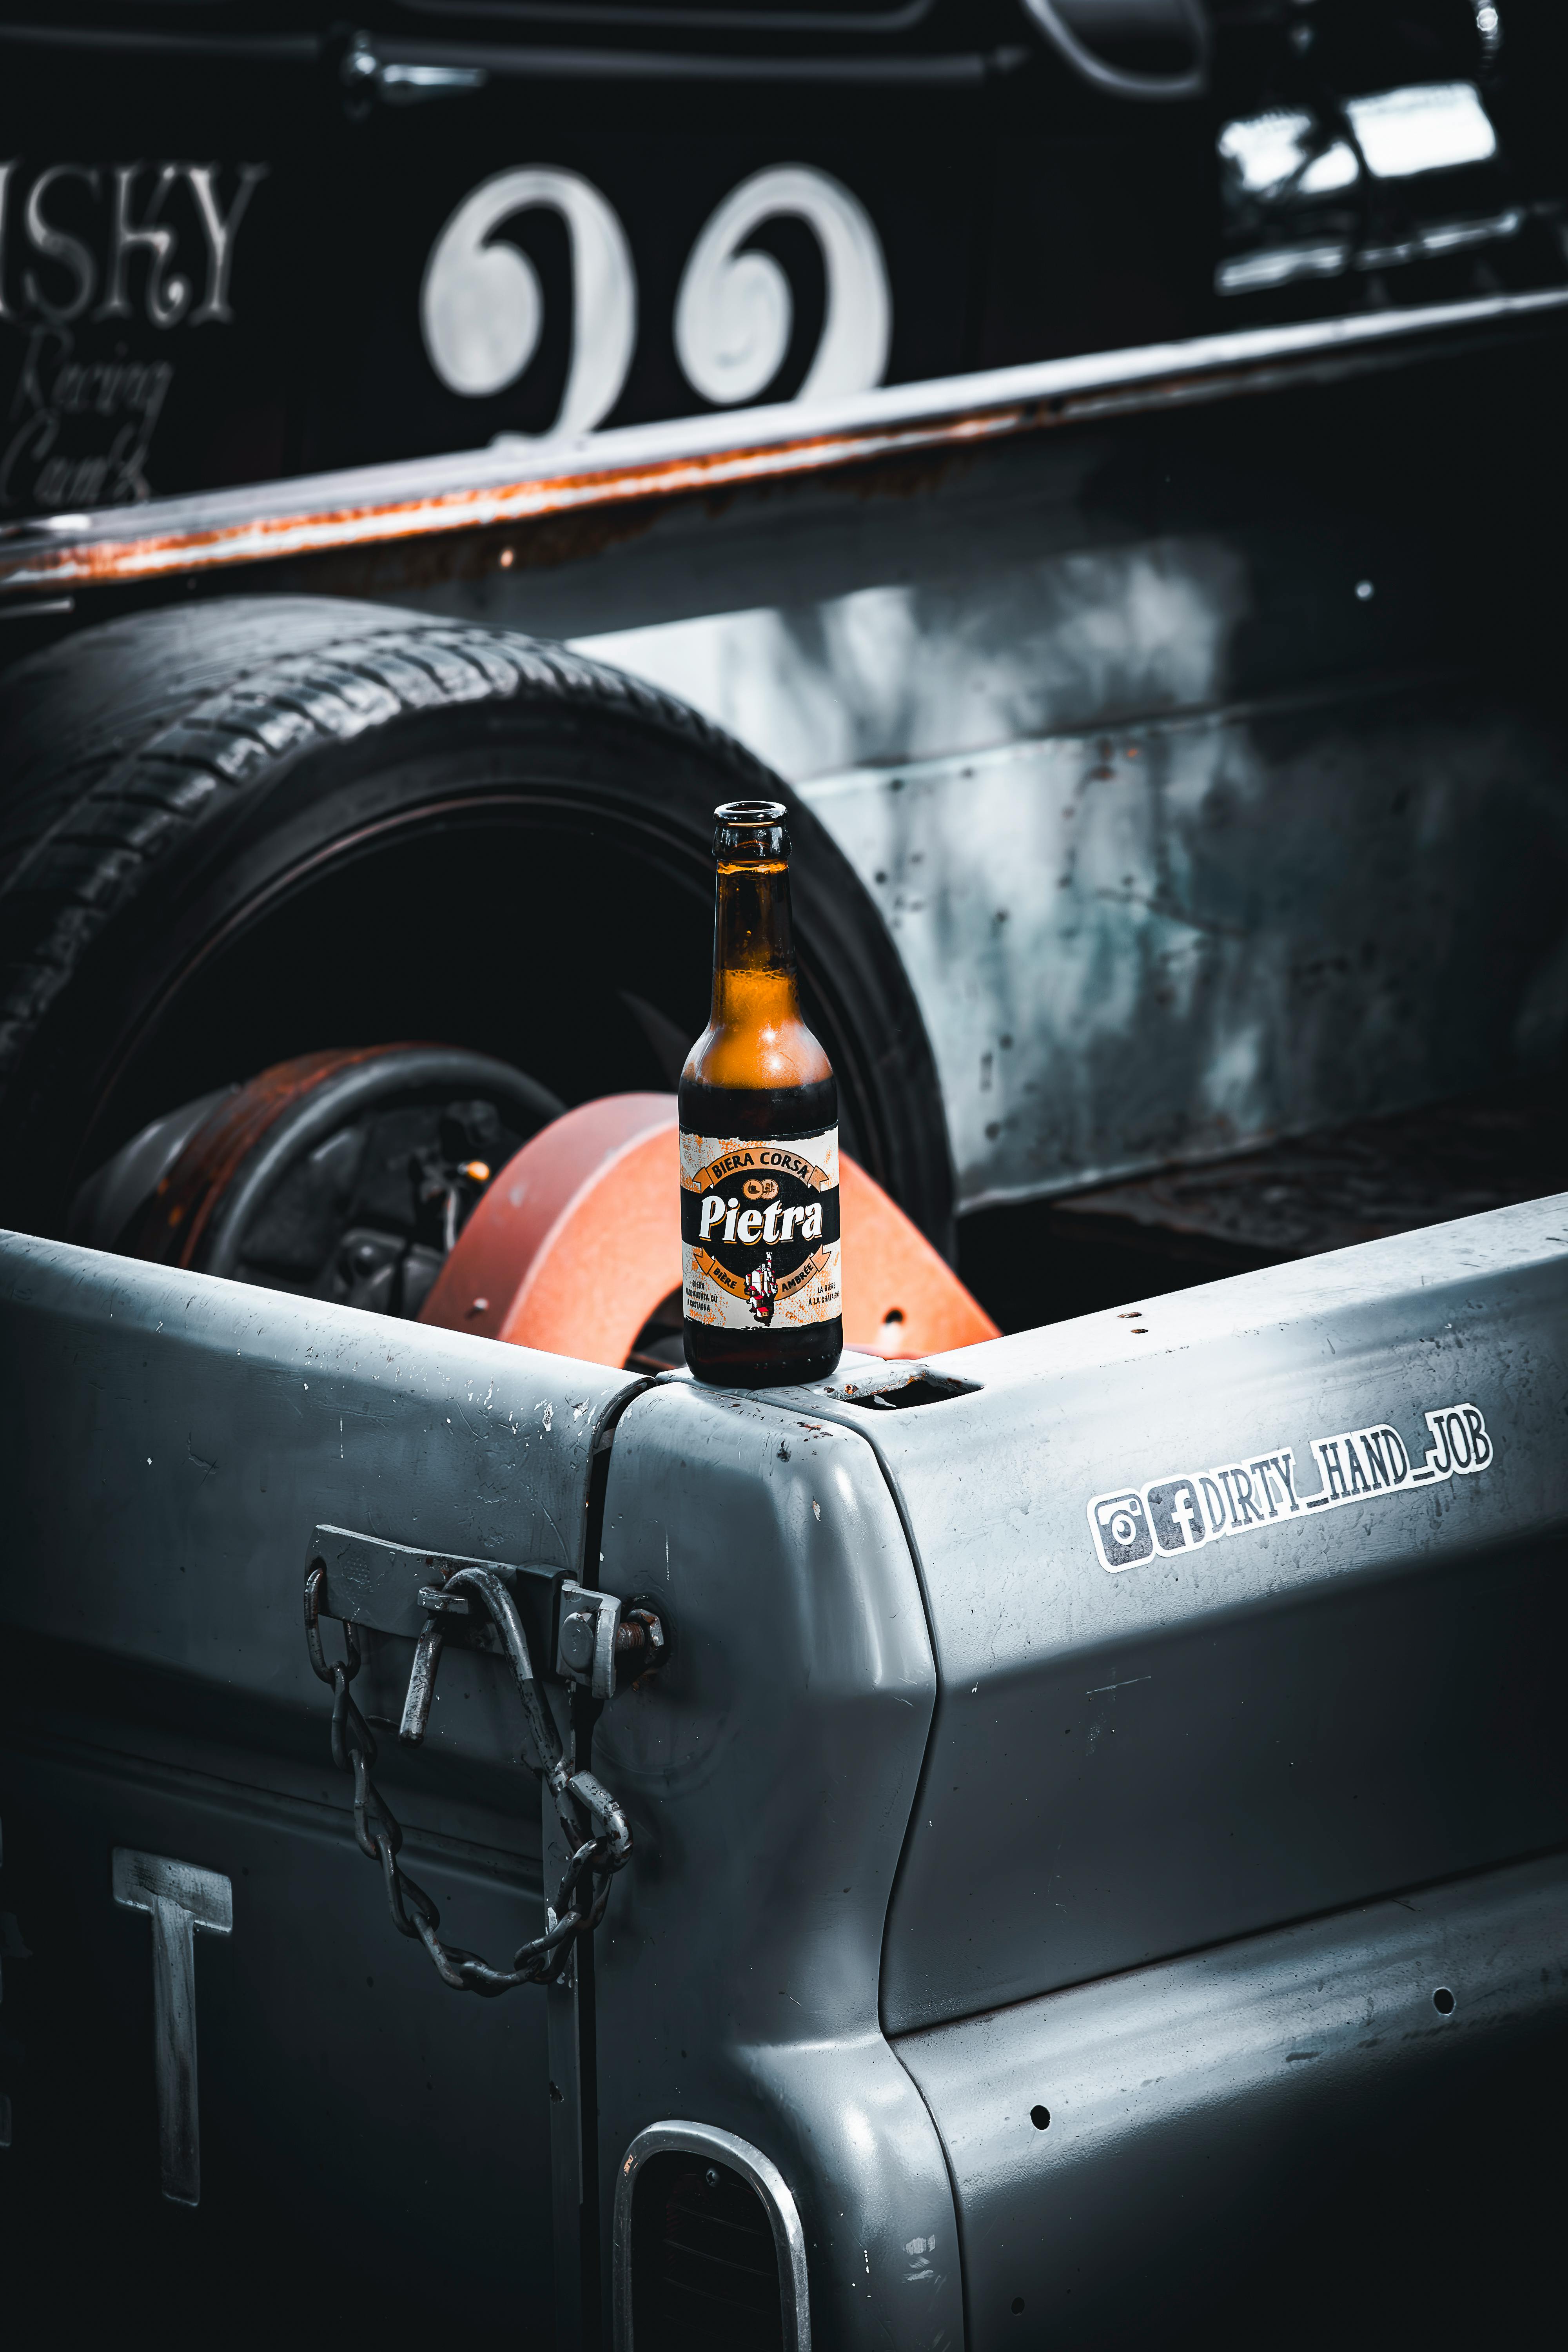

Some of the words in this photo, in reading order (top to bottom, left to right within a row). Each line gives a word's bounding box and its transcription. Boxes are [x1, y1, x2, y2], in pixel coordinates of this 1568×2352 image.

[711, 1152, 755, 1179] BIERA
[760, 1152, 808, 1179] CORSA
[699, 1195, 822, 1245] Pietra
[692, 1280, 705, 1290] BIERA
[713, 1267, 737, 1289] BIÈRE
[782, 1262, 814, 1292] AMBRÉE
[824, 1282, 835, 1292] BIÈRE
[808, 1297, 812, 1306] À
